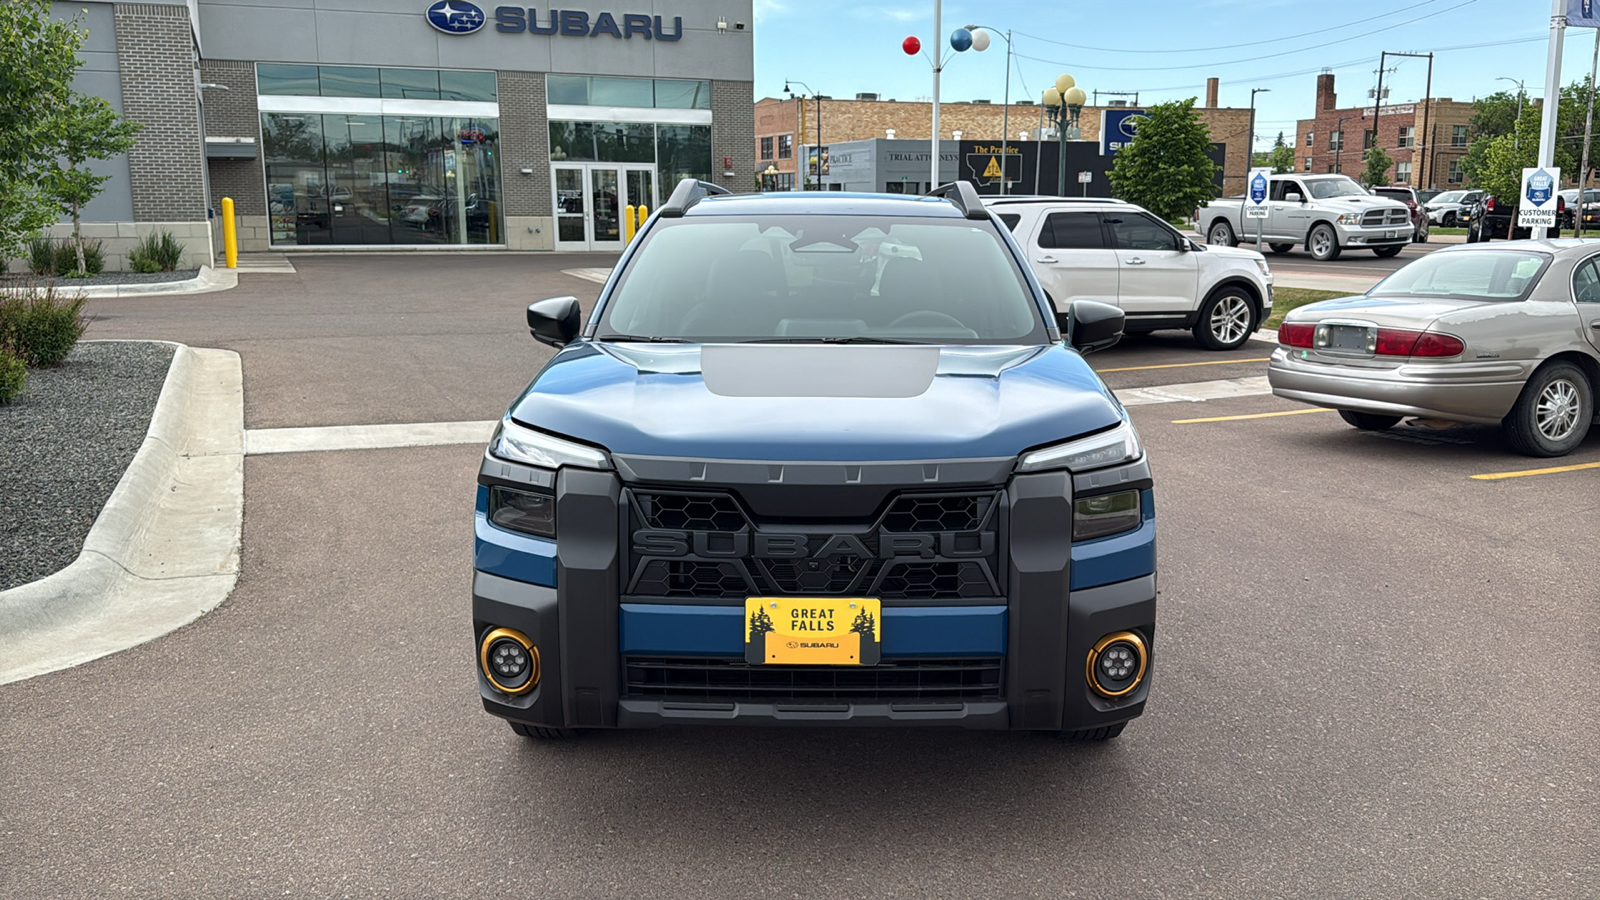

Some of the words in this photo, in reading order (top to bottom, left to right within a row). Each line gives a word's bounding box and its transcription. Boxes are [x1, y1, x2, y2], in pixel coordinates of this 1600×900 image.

[495, 6, 682, 41] SUBARU
[990, 145, 1019, 154] Pratice
[1519, 209, 1557, 217] CUSTOMER
[632, 529, 996, 559] SUBARU
[791, 608, 835, 619] GREAT
[791, 620, 835, 631] FALLS
